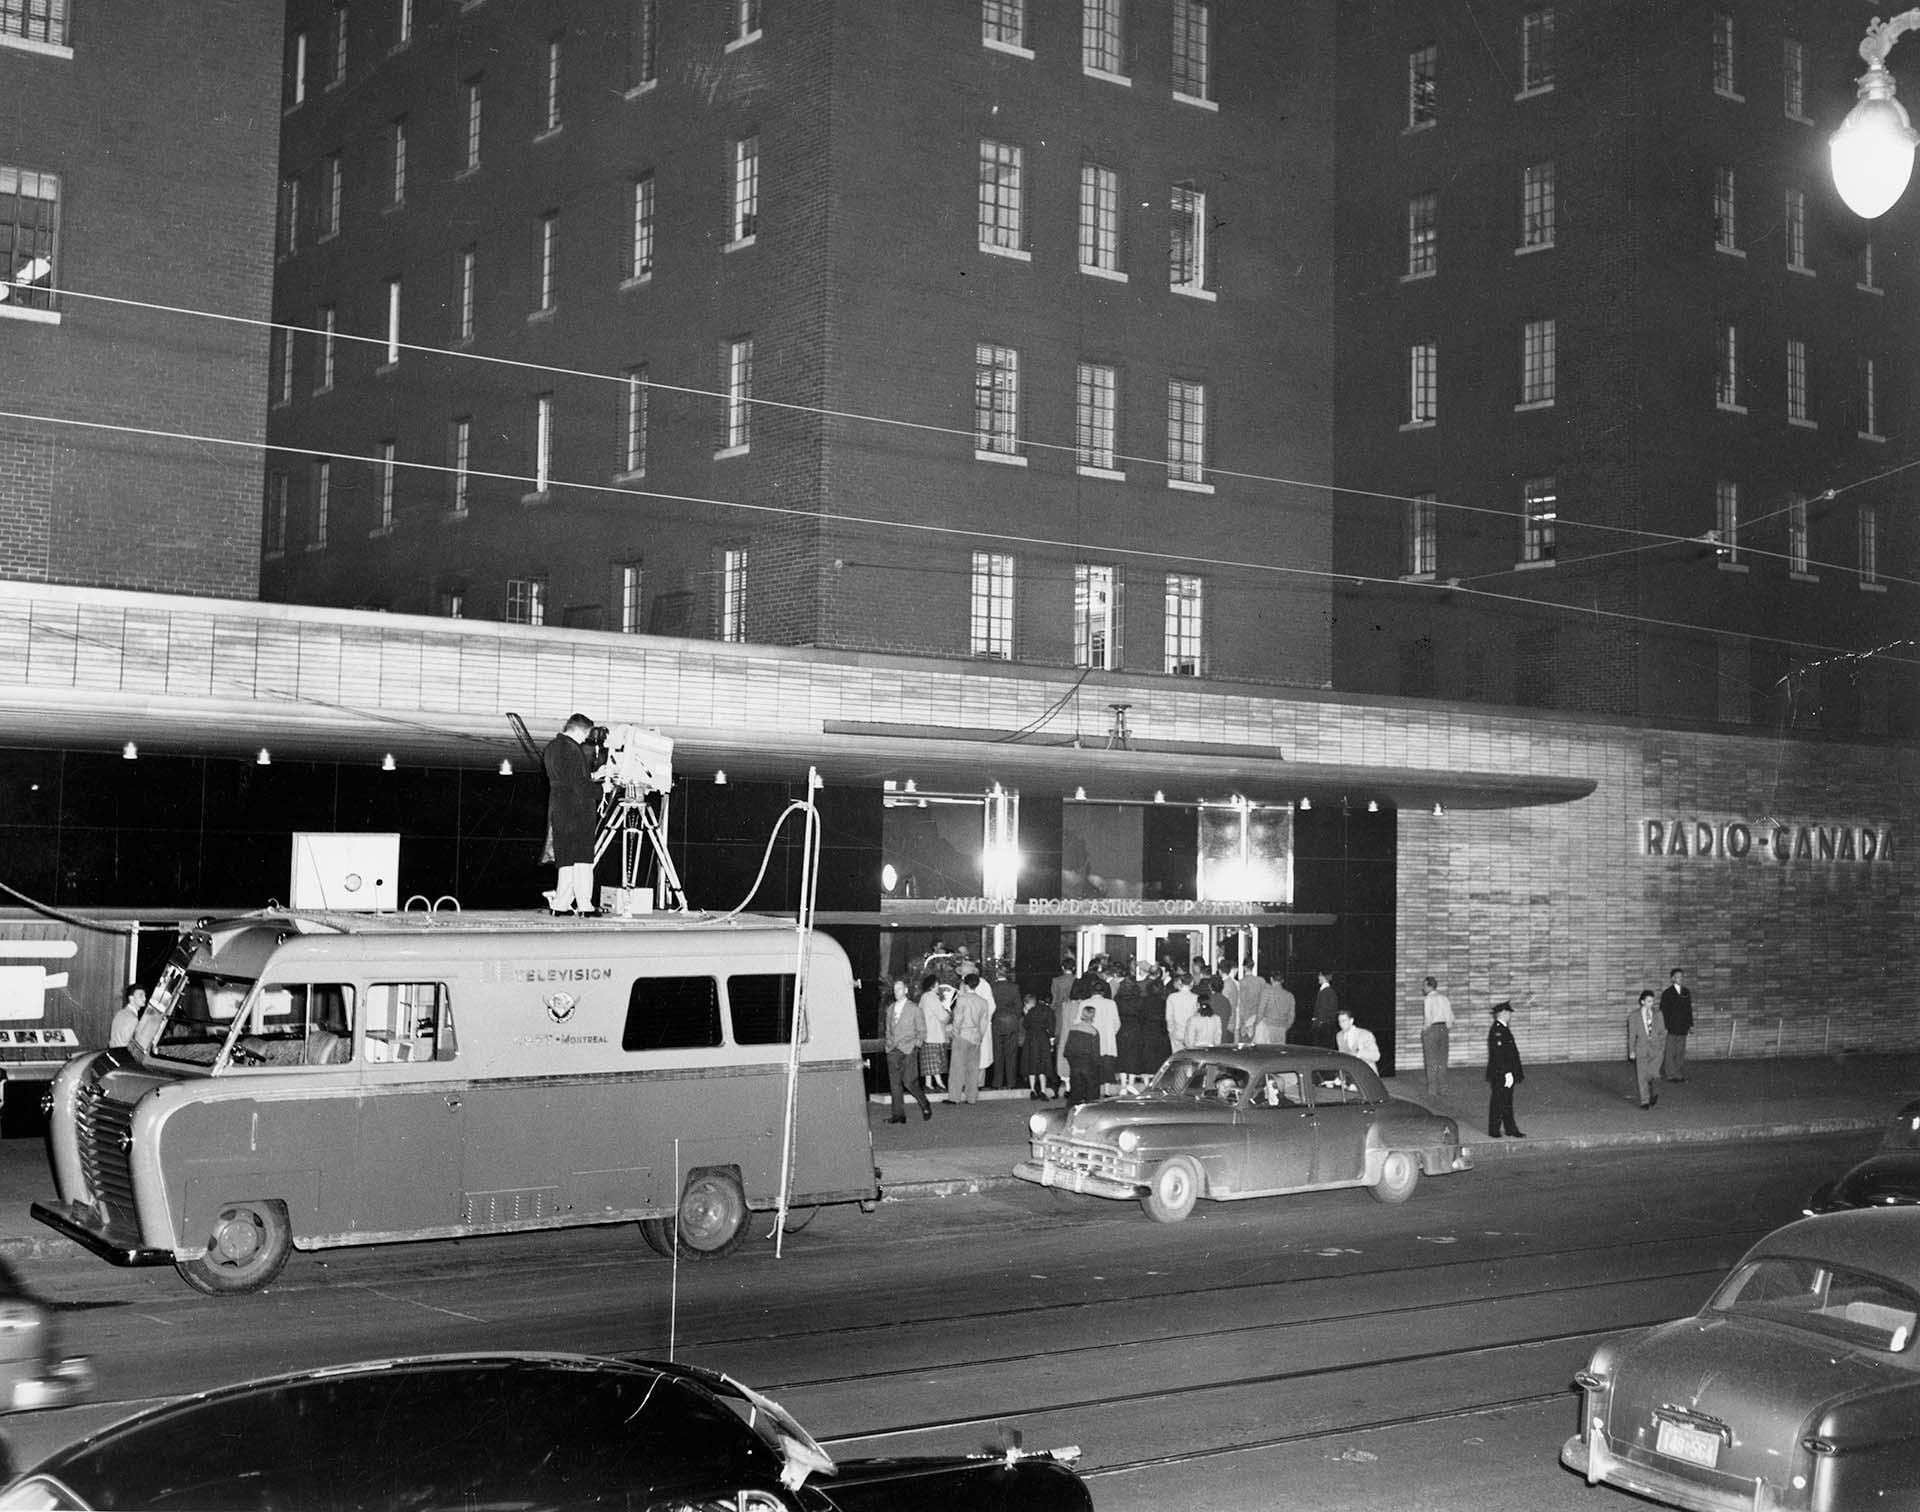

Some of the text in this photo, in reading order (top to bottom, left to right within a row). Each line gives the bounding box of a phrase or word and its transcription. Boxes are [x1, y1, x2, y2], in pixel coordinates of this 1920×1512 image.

[1638, 817, 1896, 862] RADIO-CANADA
[935, 897, 1015, 914] CANADIAN
[1028, 898, 1143, 916] BROADCASTING
